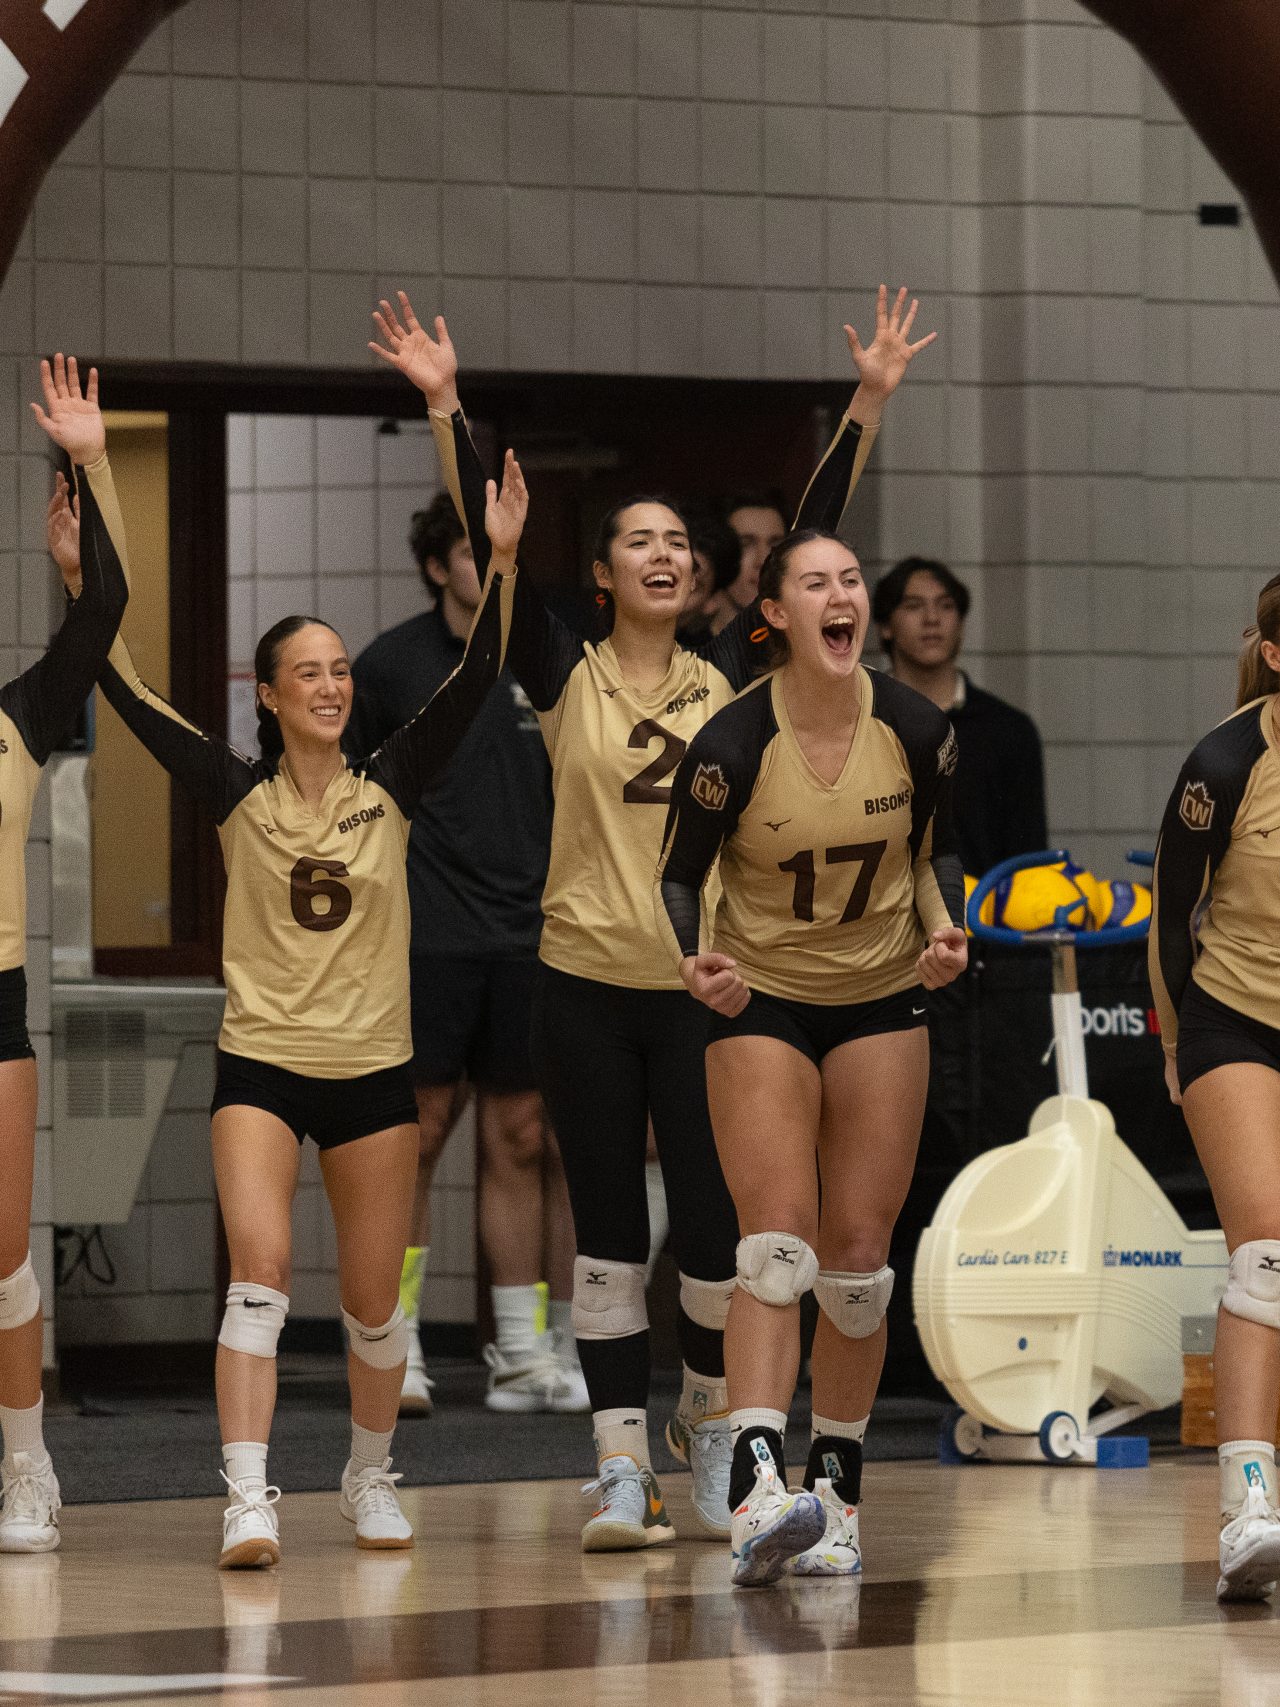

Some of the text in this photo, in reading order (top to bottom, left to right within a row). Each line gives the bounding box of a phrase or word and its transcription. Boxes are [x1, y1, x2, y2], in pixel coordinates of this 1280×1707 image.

[865, 789, 910, 816] BISONS
[338, 804, 386, 834] BISONS
[291, 856, 352, 931] 6
[778, 839, 888, 924] 17
[1003, 1250, 1030, 1265] Care
[1120, 1251, 1182, 1266] MONARK
